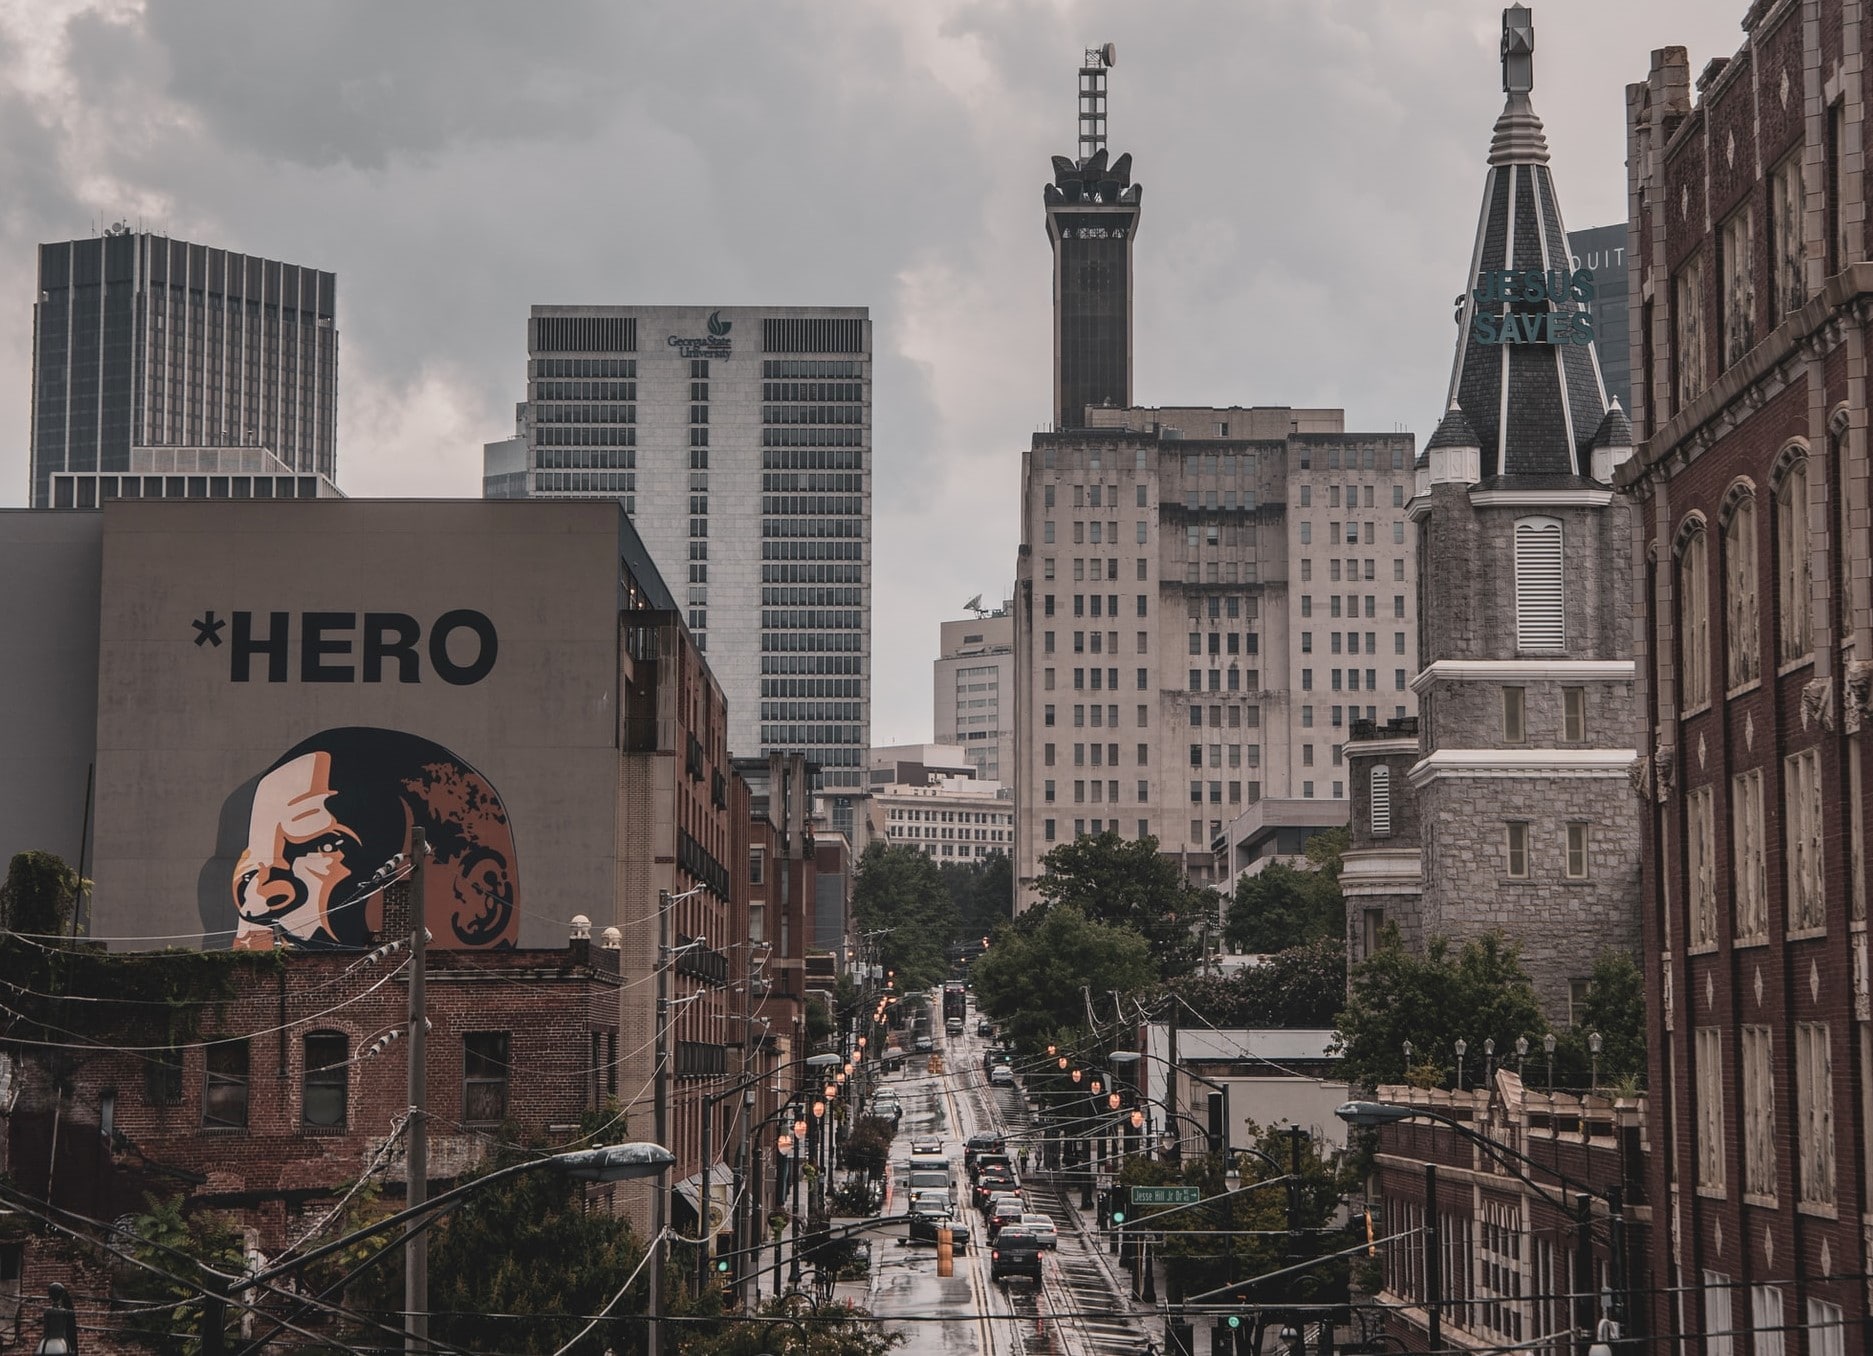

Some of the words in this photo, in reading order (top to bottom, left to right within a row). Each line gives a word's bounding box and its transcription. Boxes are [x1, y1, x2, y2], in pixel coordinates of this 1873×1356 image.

[1473, 268, 1595, 303] JESUS
[1474, 311, 1595, 345] SAVES
[667, 335, 707, 350] Georgia
[707, 335, 732, 346] State
[680, 346, 732, 362] University
[1135, 1190, 1153, 1202] Jesse
[1154, 1190, 1165, 1201] Hill
[1167, 1190, 1174, 1201] Jr
[1175, 1190, 1183, 1201] Dr
